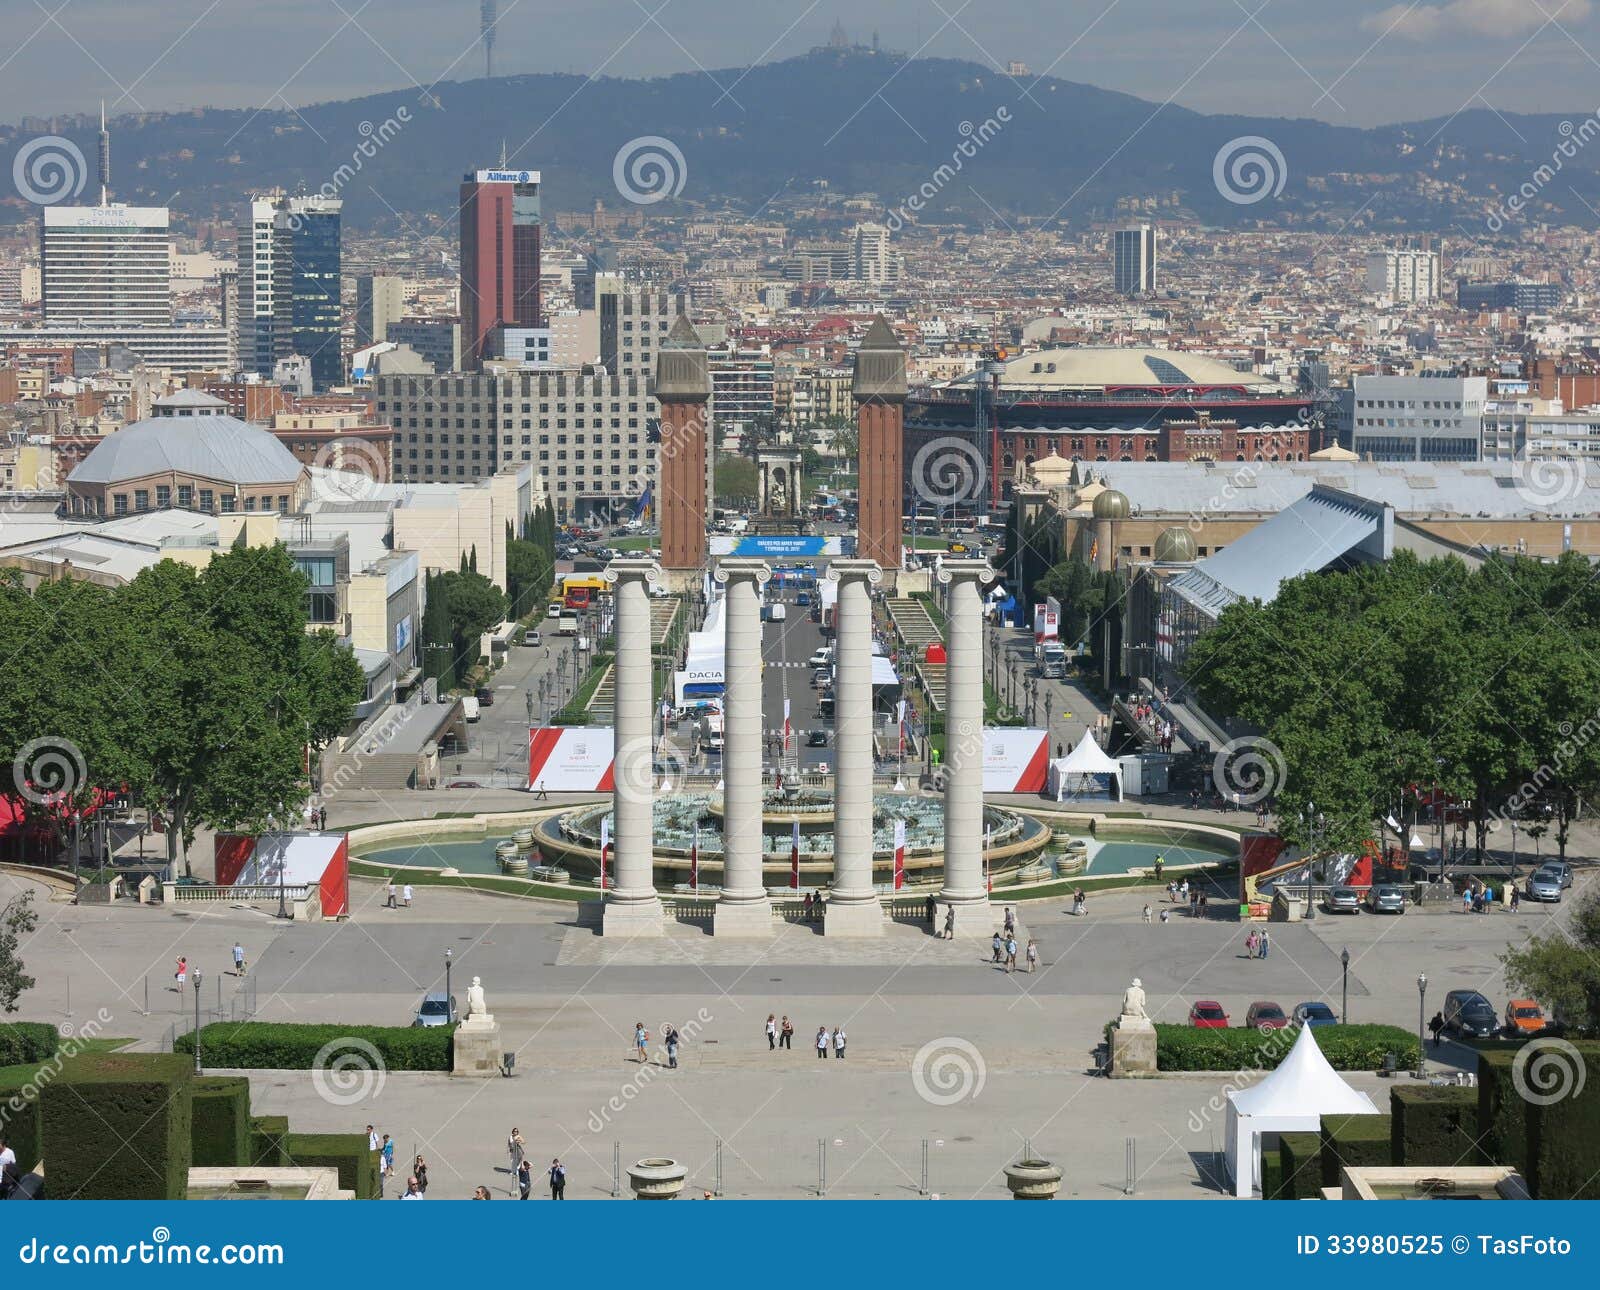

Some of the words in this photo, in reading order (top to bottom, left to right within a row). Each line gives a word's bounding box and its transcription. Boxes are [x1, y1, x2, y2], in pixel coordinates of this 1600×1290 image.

[486, 172, 518, 182] Allianz
[91, 208, 125, 217] TORRE
[77, 218, 138, 226] CATALUNYA
[689, 671, 722, 679] DACIA
